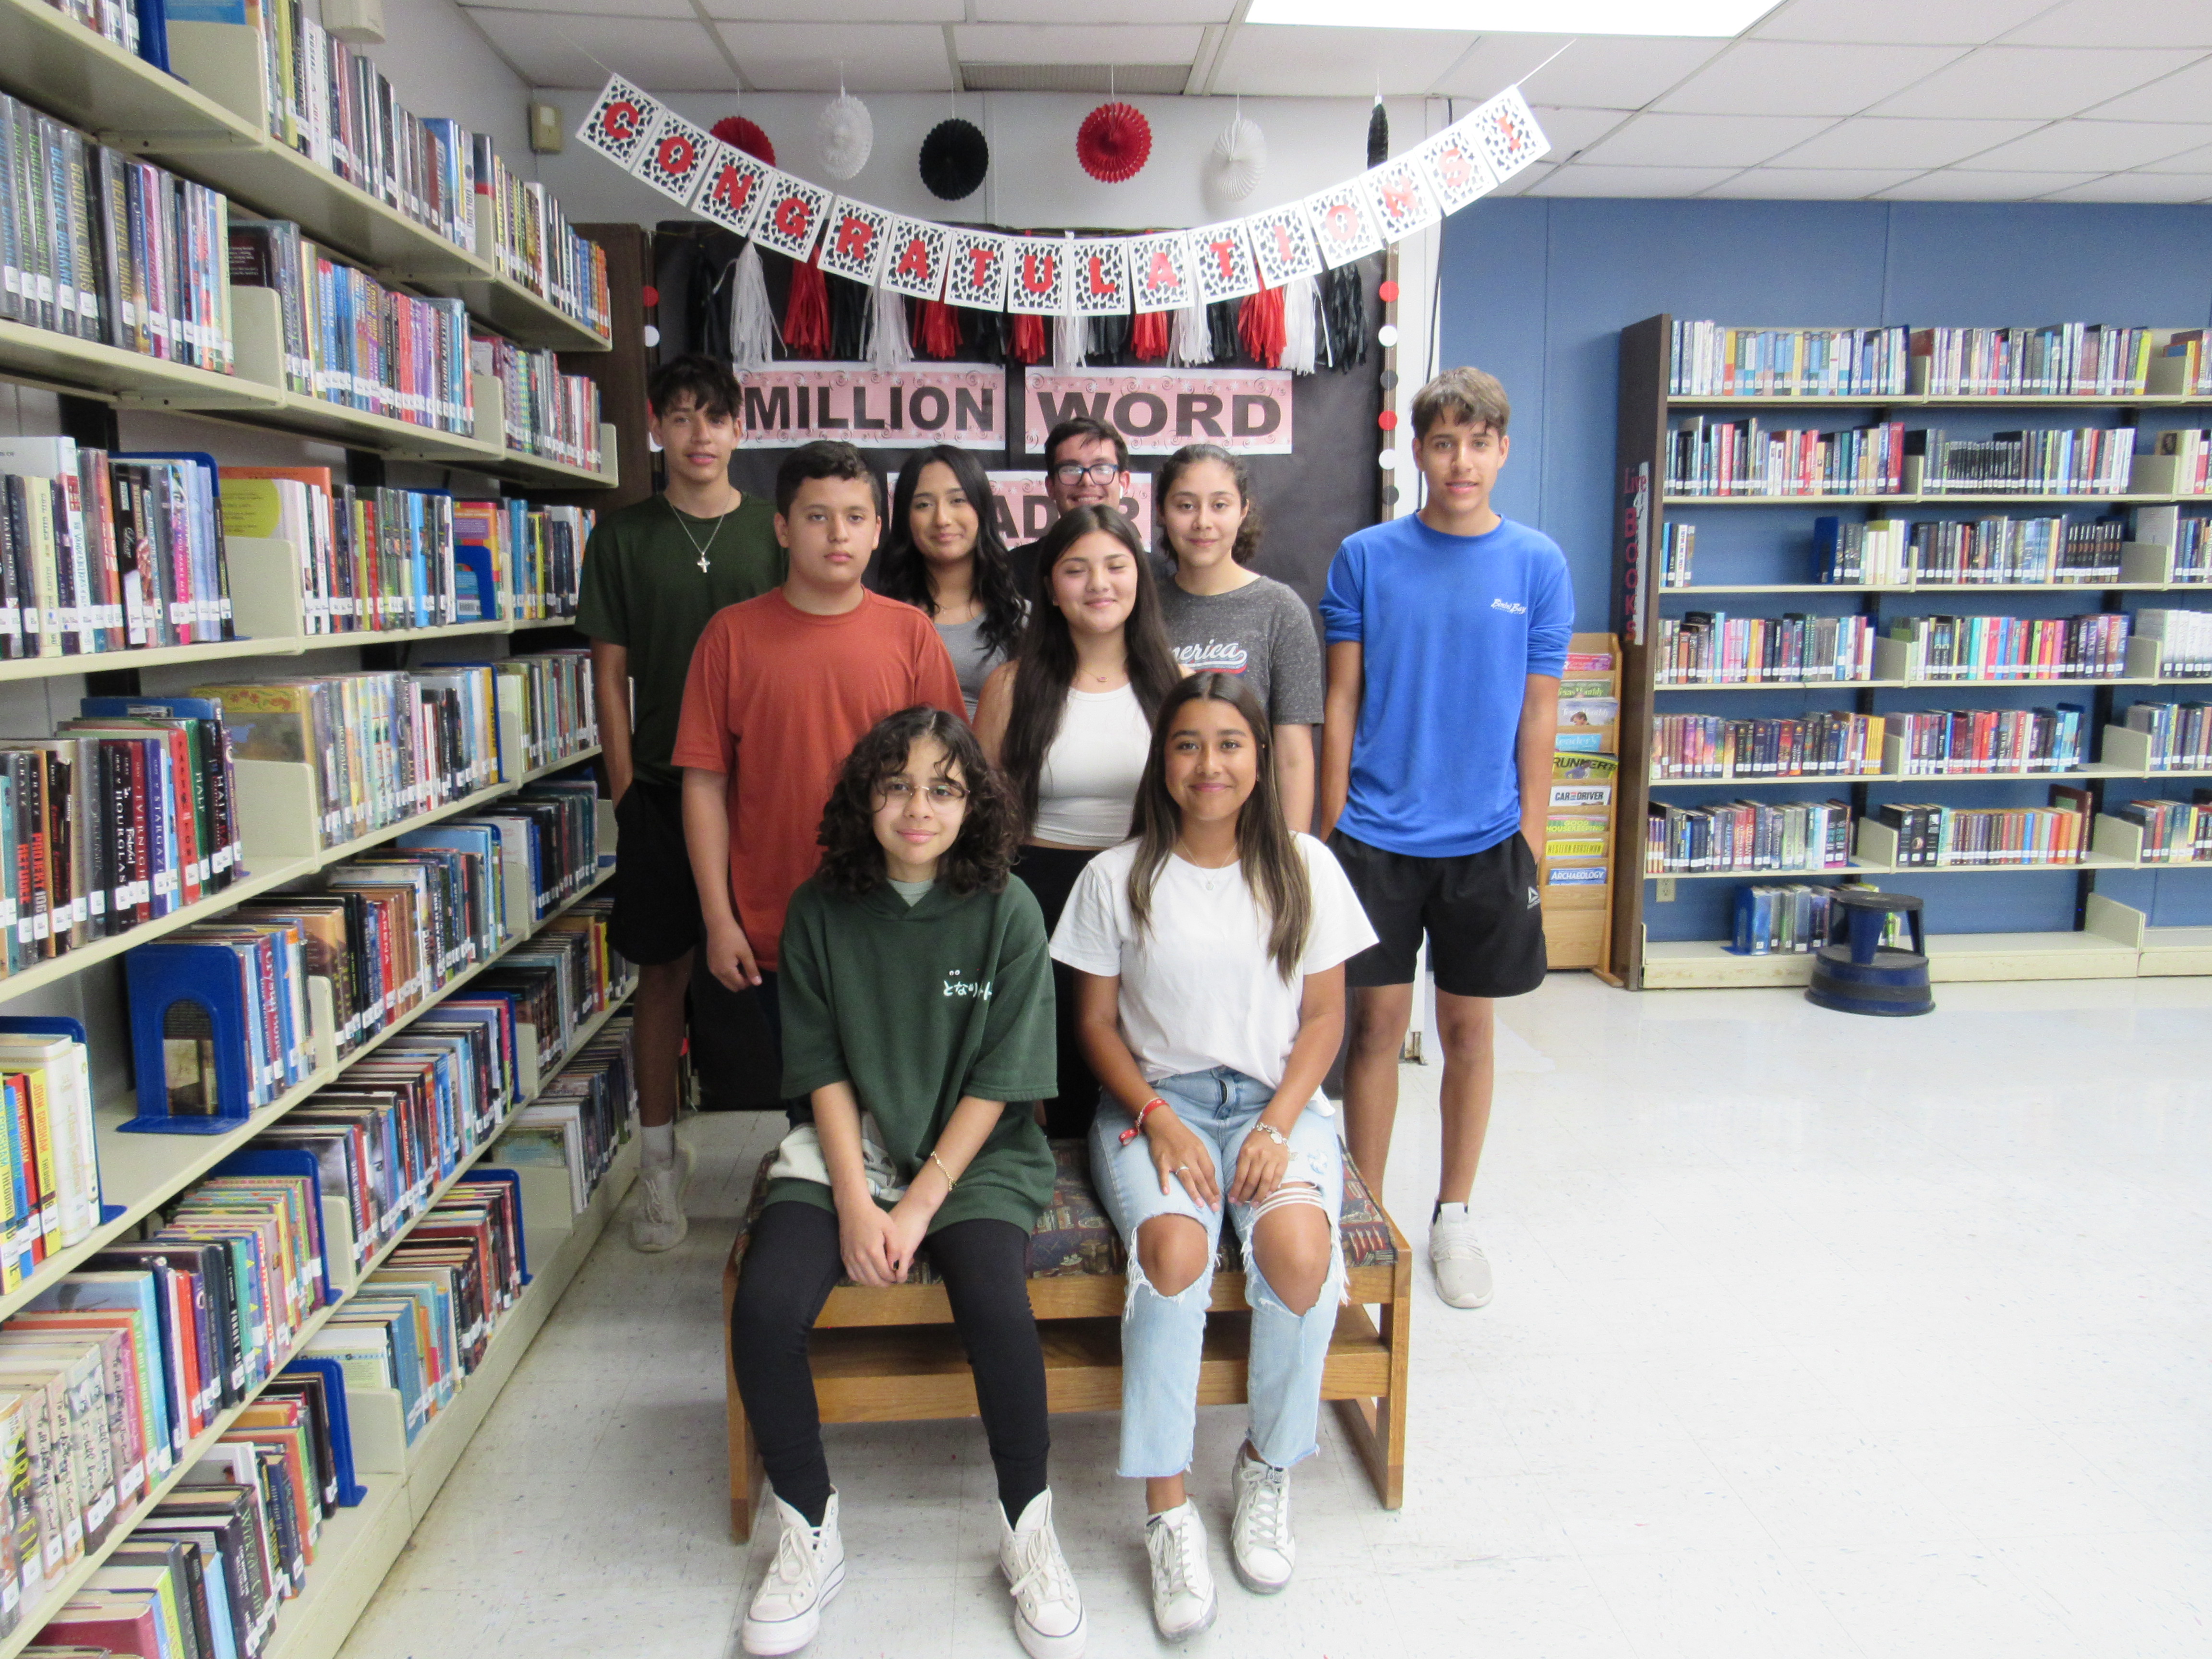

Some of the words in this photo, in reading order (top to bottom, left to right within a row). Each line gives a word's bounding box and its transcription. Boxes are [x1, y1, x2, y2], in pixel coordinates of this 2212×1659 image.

[50, 147, 68, 224] BEAUTIFUL
[71, 163, 88, 237] BEAUTIFUL
[604, 101, 1521, 294] CONGRATULATIONS!
[112, 180, 129, 251] BEAUTIFUL
[77, 245, 96, 292] CHAOS
[119, 258, 132, 301] CHAOS
[745, 386, 994, 431] MILLION
[1038, 391, 1282, 437] WORD
[180, 581, 185, 592] ME
[195, 772, 205, 812] HALF
[1555, 793, 1570, 801] CAR
[1577, 792, 1603, 801] DRIVER
[115, 790, 126, 883] HOURGLAS
[17, 844, 31, 904] REFUGEE
[32, 832, 46, 889] PROJEKT
[1551, 871, 1604, 880] ARCHAEOLOGY
[381, 910, 390, 964] ARENA
[34, 1084, 45, 1110] JOHN
[37, 1110, 49, 1153] GRISHAM
[1, 1171, 14, 1216] THEODORE
[42, 1158, 51, 1191] THEODORE
[230, 1309, 241, 1348] FORGET
[140, 1372, 150, 1410] SUMMER
